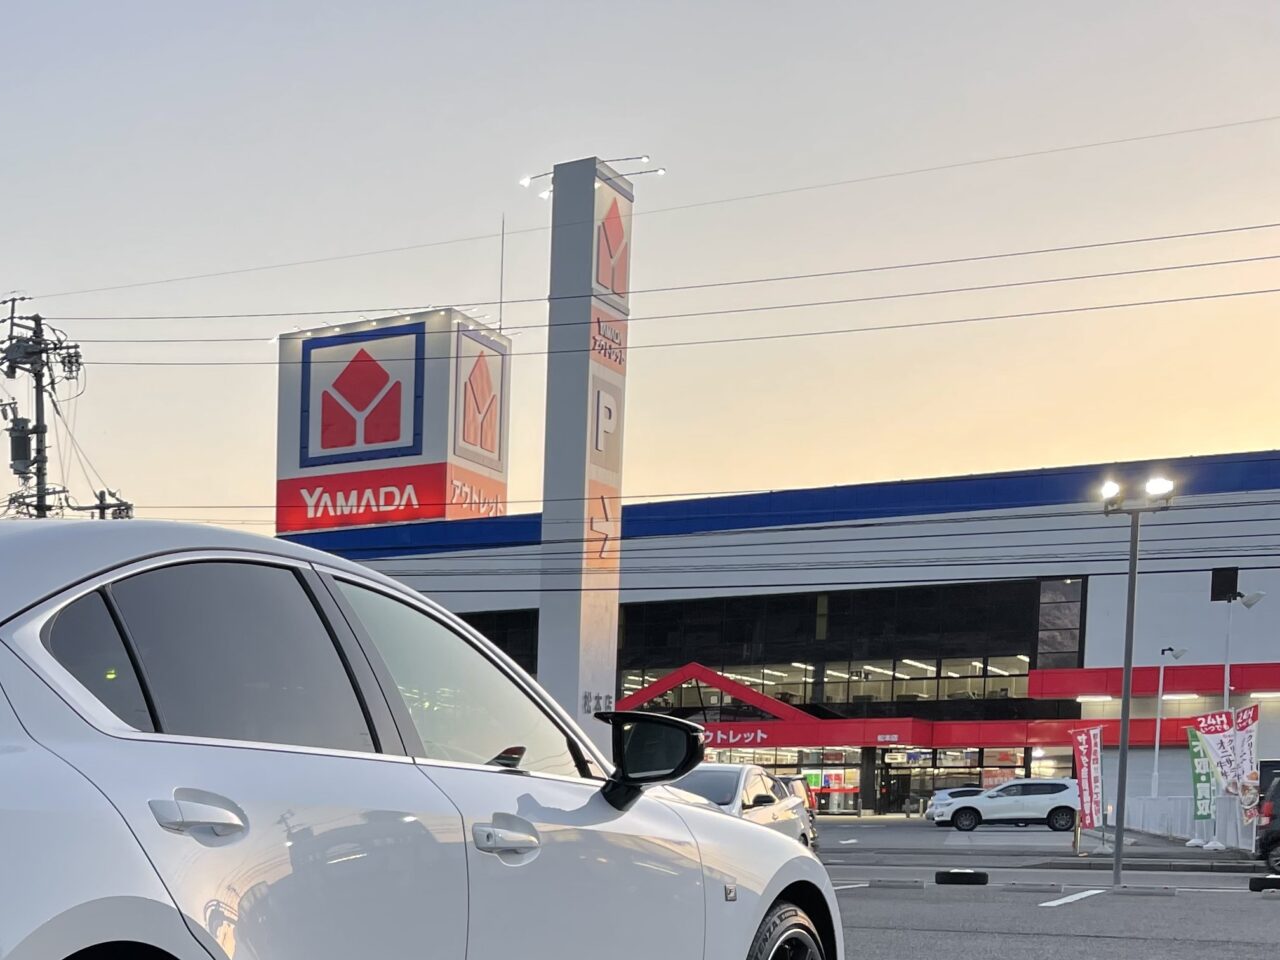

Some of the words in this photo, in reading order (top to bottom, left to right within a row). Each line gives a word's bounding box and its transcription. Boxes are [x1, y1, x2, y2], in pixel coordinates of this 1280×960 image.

[595, 389, 618, 453] P
[299, 484, 419, 518] YAMADA
[451, 479, 504, 517] アウトレット
[1197, 713, 1227, 727] 24H
[1200, 724, 1229, 734] いつでも
